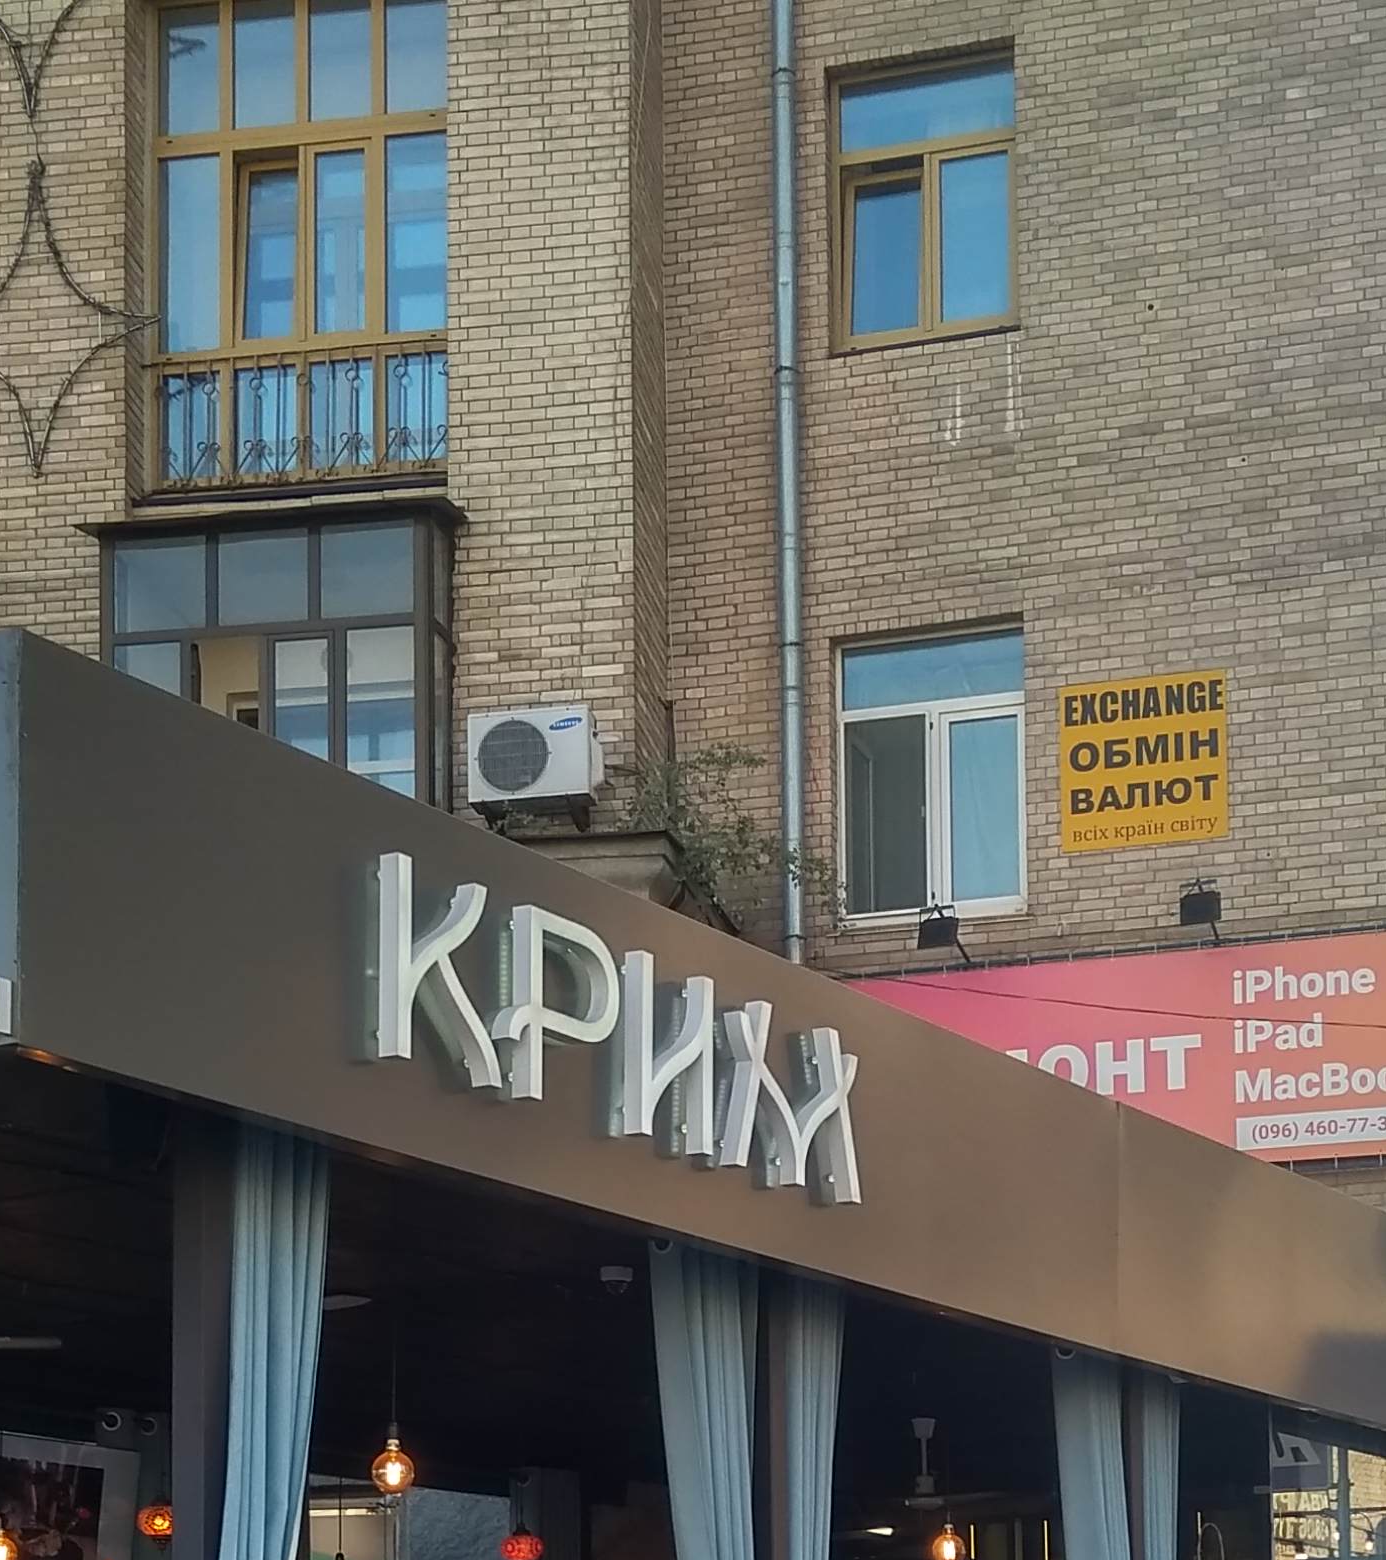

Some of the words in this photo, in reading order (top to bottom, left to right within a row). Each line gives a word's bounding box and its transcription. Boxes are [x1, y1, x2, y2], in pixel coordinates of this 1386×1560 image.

[1064, 679, 1224, 727] EXCHANGE
[1069, 728, 1219, 772] ОБМІН
[1070, 774, 1219, 815] ВАЛЮТ
[1072, 824, 1109, 843] всіх
[1114, 819, 1165, 842] країн
[1170, 815, 1219, 834] світу
[1232, 966, 1377, 1005] iPhone
[377, 851, 862, 1205] КРИМ
[1233, 1012, 1324, 1054] iPad
[1005, 1033, 1202, 1096] ОНТ
[1251, 1121, 1300, 1144] (096)
